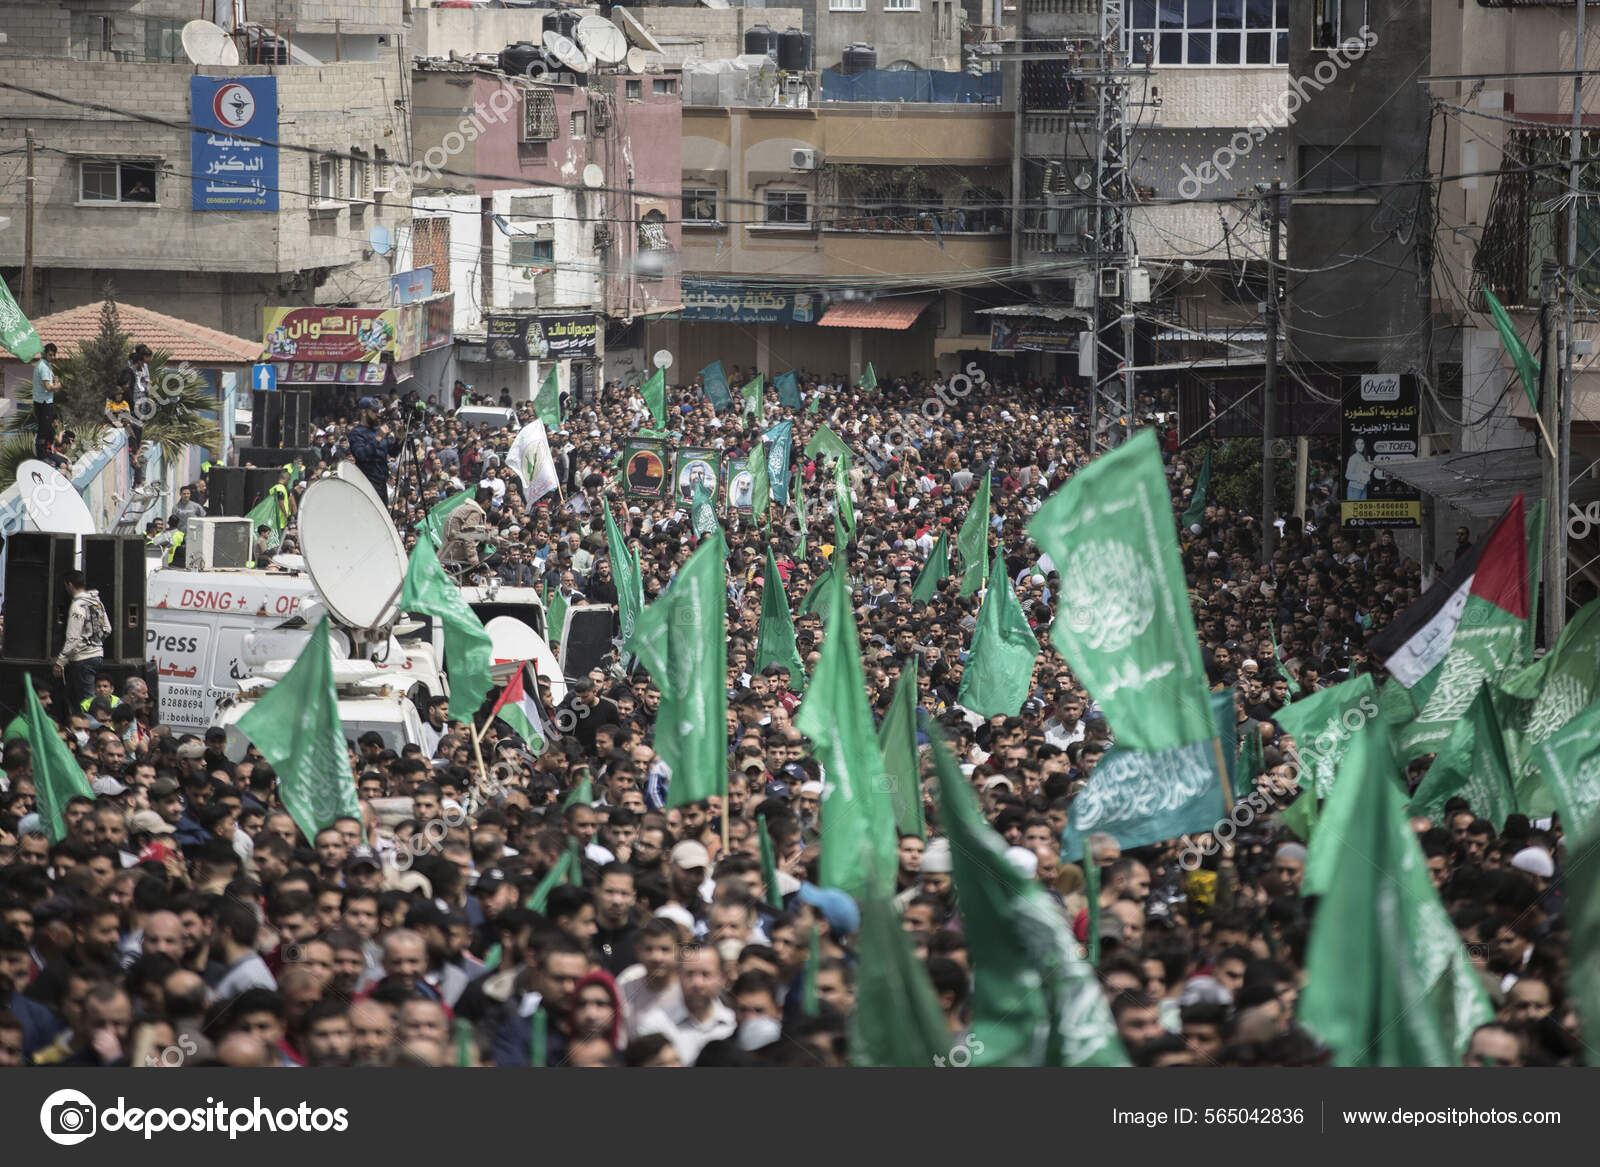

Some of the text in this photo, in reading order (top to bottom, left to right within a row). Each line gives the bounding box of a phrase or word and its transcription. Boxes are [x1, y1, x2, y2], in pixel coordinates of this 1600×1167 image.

[205, 155, 264, 175] الدكتور
[743, 290, 787, 315] مكتبة
[287, 314, 359, 340] ألوان
[1363, 379, 1397, 394] Oxford
[1388, 442, 1413, 451] TOEFL
[180, 589, 233, 610] DSNG
[146, 629, 198, 653] Press
[168, 686, 235, 699] Booking Center
